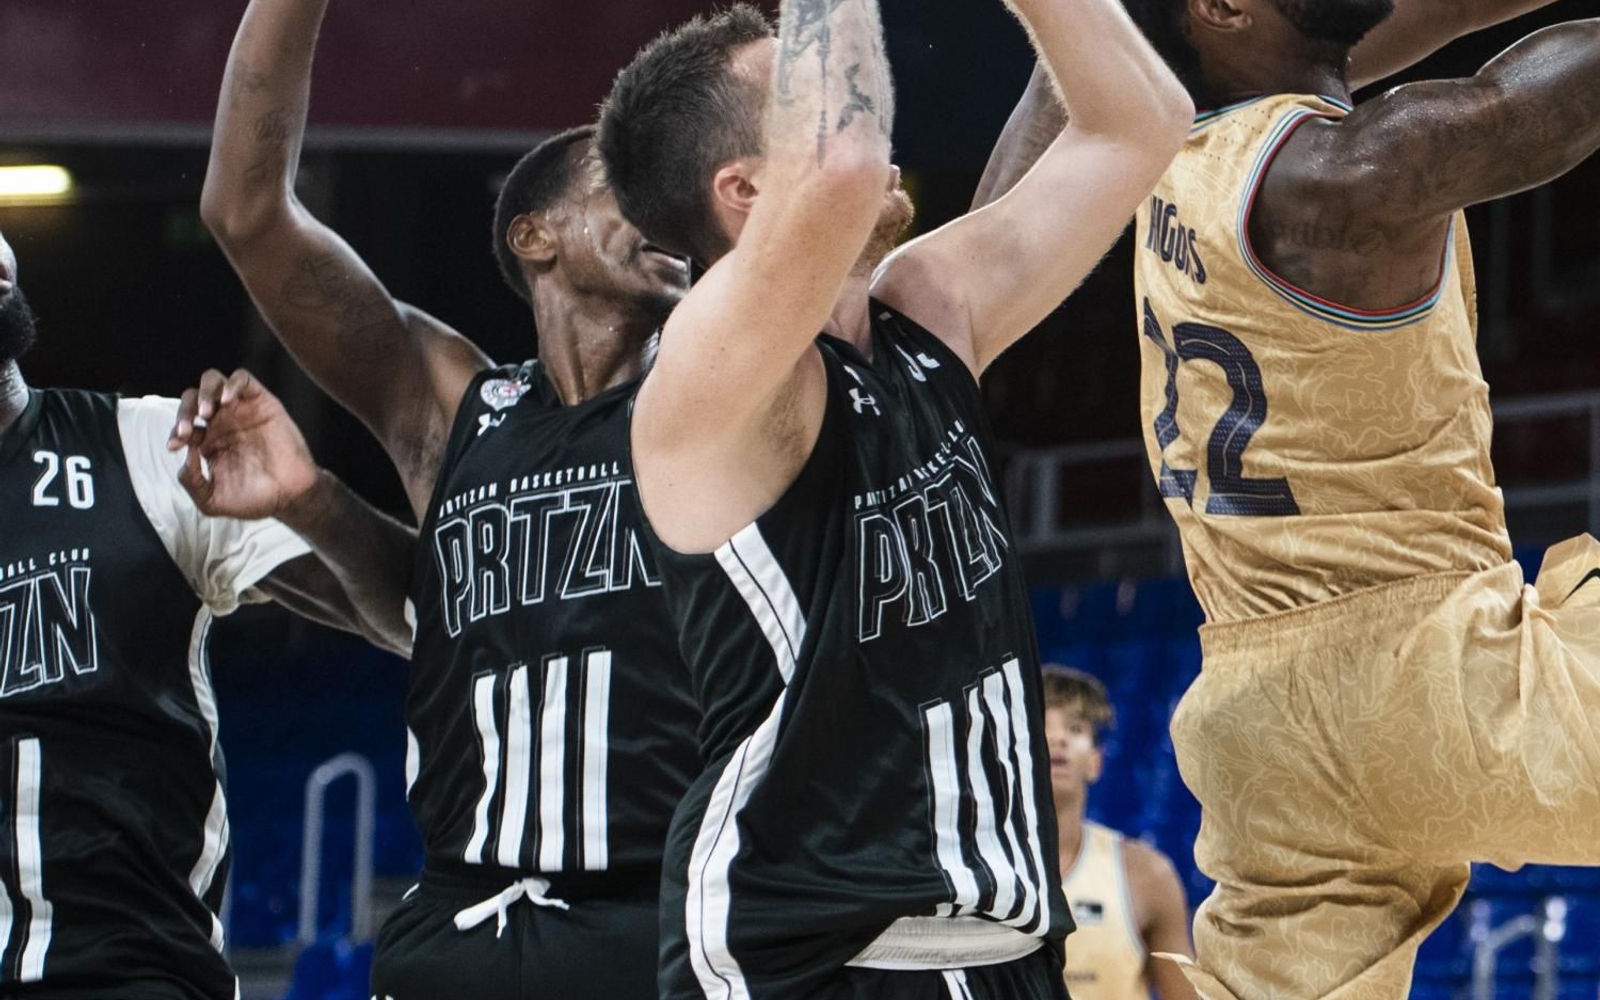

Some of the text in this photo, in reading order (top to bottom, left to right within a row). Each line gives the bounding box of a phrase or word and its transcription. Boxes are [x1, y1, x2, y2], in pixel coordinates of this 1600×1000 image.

[1143, 297, 1301, 516] 22
[32, 450, 95, 509] 26
[509, 461, 620, 493] BASKETBALL
[49, 548, 90, 566] CLUB
